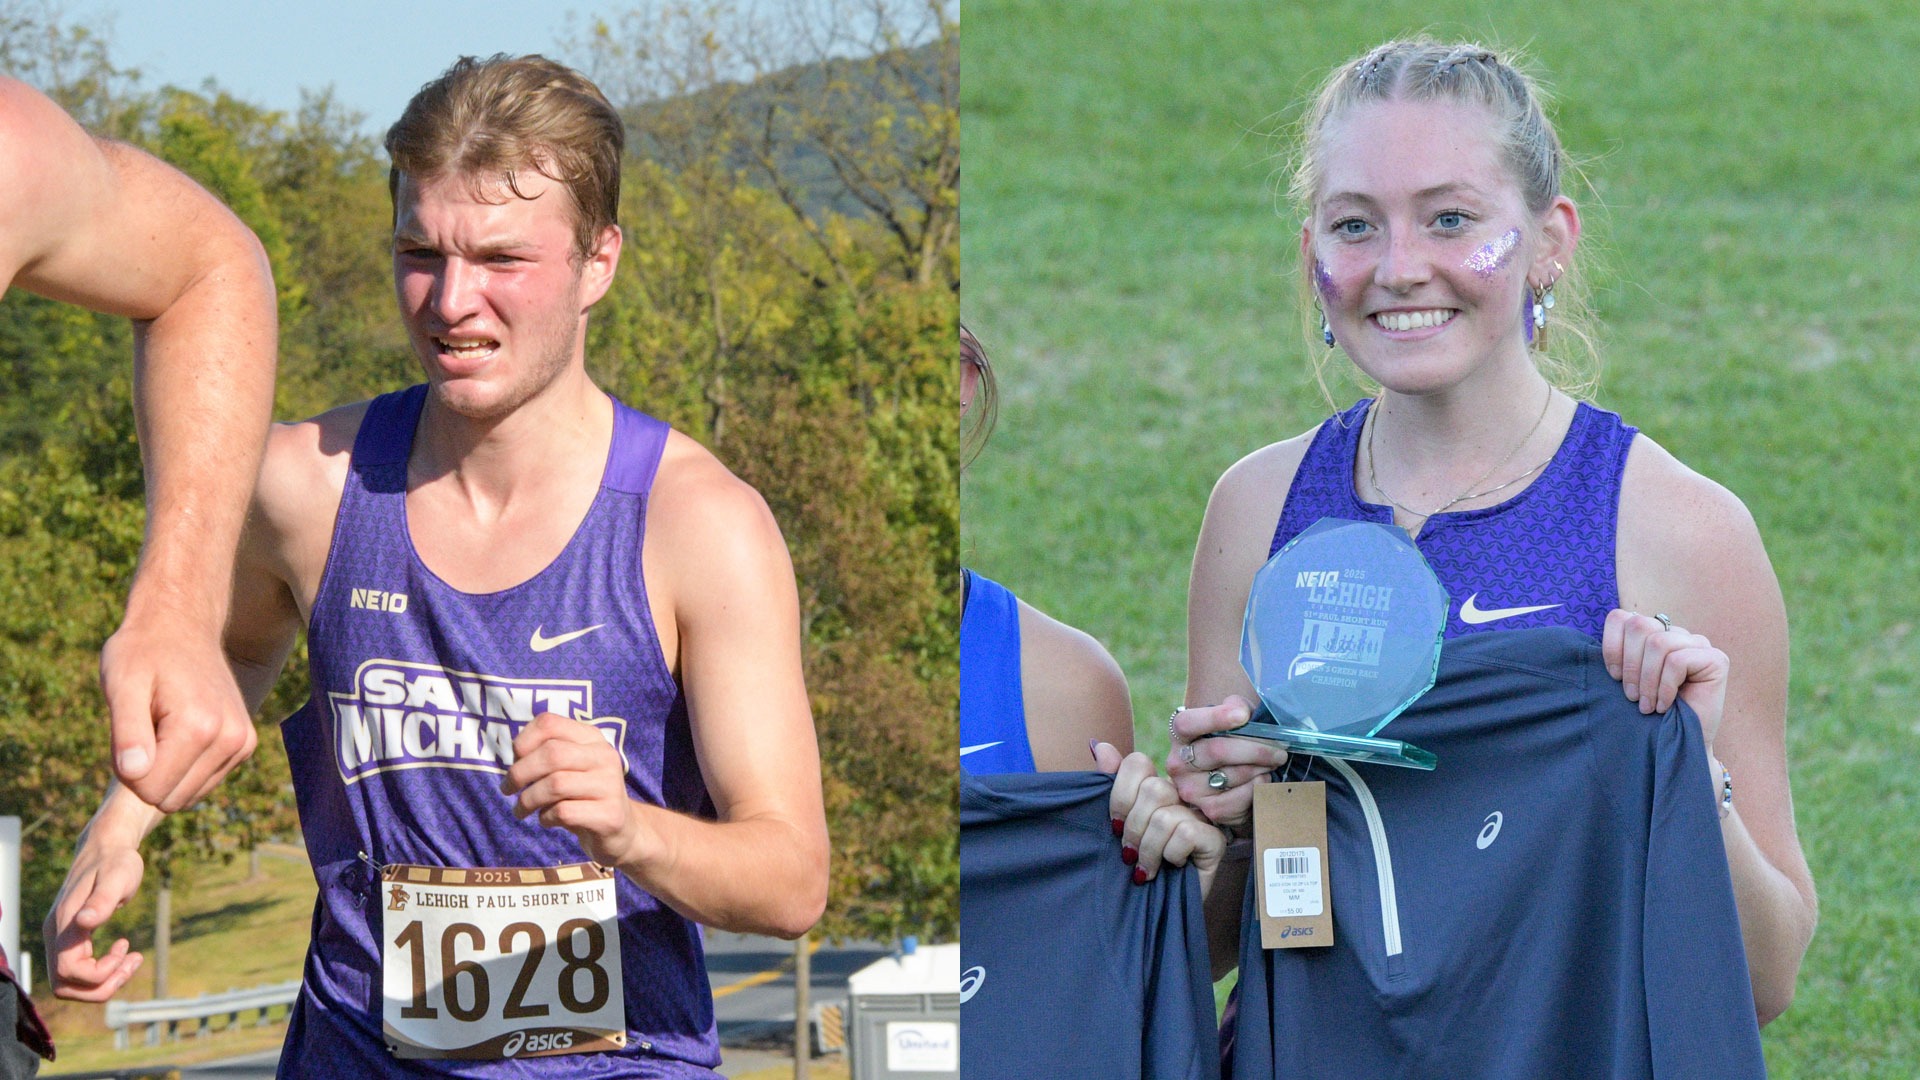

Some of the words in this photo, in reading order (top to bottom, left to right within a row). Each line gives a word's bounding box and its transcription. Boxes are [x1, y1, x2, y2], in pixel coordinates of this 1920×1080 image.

[1344, 569, 1365, 579] 2025
[350, 588, 408, 614] NE10
[1308, 580, 1394, 611] LEHIGH
[1318, 612, 1339, 622] PAUL
[1341, 616, 1370, 625] SHORT
[1311, 674, 1359, 689] CHAMPION
[1331, 666, 1358, 676] GREEN
[1358, 669, 1380, 679] RACE
[364, 669, 582, 721] SAINT
[338, 704, 616, 770] MICHA
[474, 871, 512, 884] 2025
[416, 892, 469, 909] LEHIGH
[477, 895, 517, 909] PAUL
[522, 892, 570, 908] SHORT
[575, 888, 606, 905] RUN
[1291, 927, 1313, 936] asics
[393, 917, 610, 1023] 1628
[526, 1032, 573, 1051] asics
